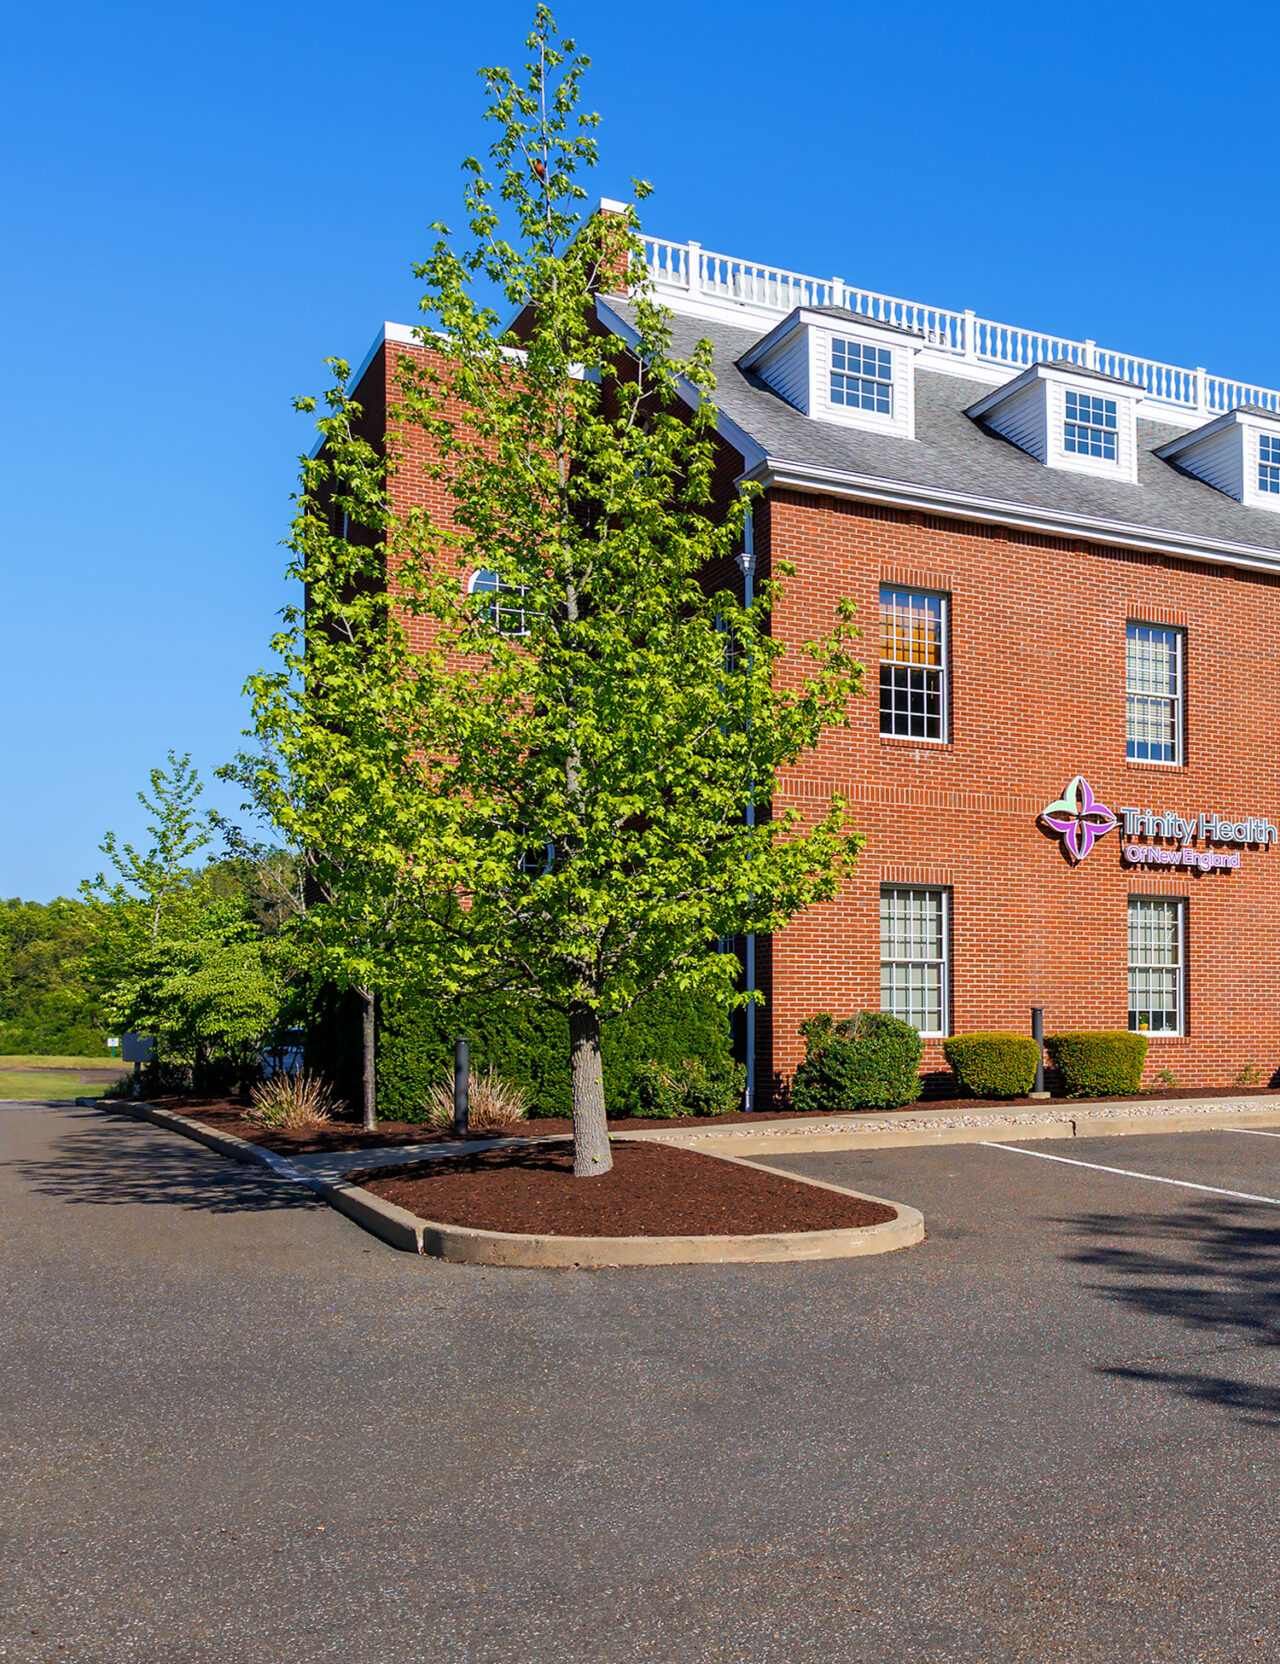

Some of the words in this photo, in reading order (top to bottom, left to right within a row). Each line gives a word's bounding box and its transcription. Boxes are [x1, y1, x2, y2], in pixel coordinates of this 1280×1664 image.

[1120, 807, 1196, 845] Trinity
[1199, 814, 1277, 843] Health
[1126, 846, 1147, 861] Of
[1149, 848, 1182, 863] New
[1183, 849, 1240, 870] England
